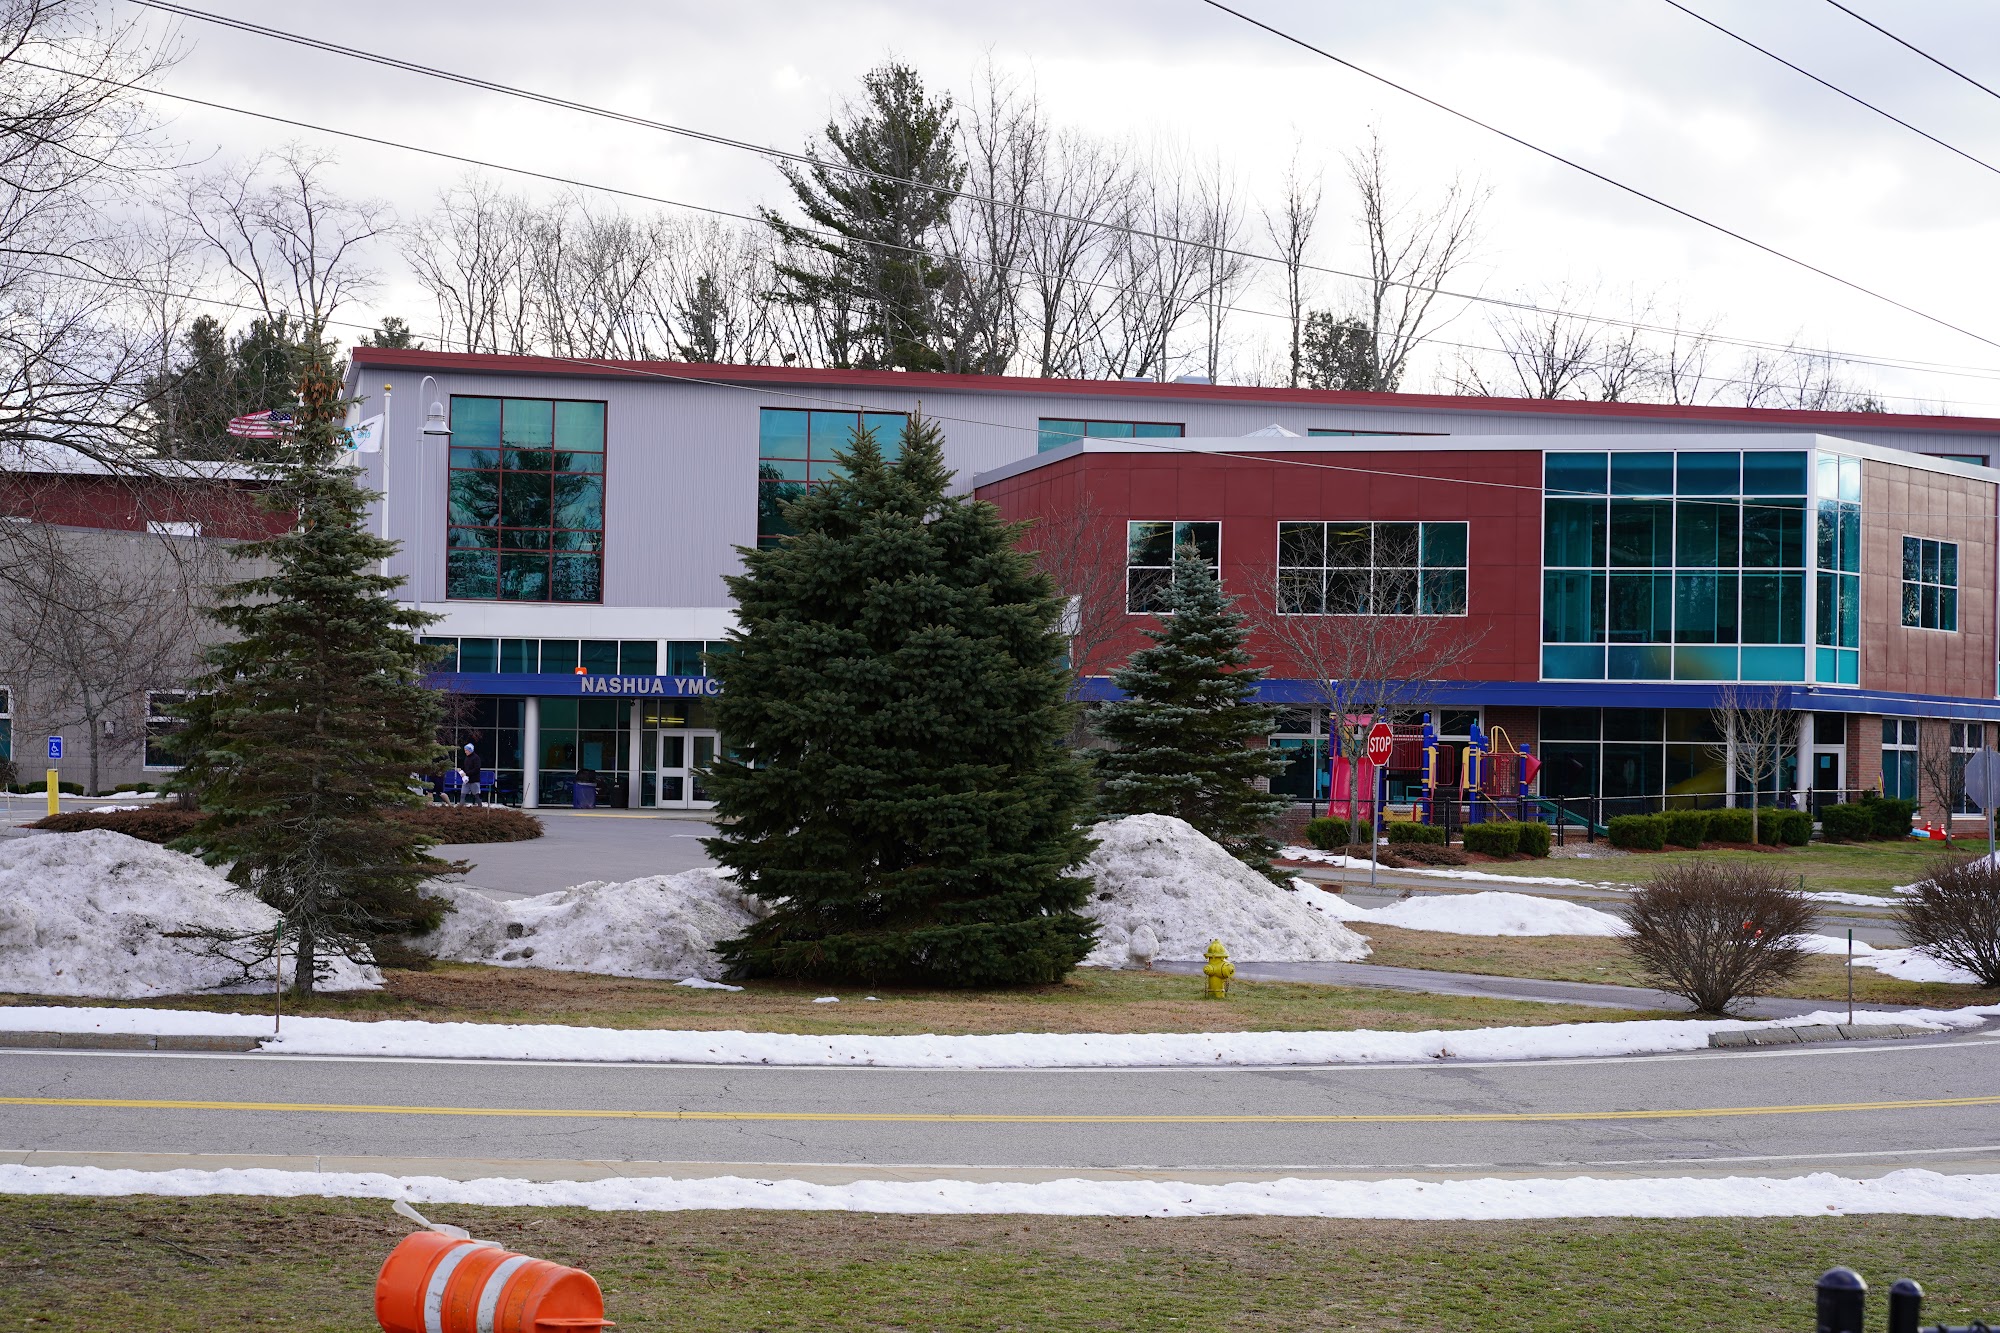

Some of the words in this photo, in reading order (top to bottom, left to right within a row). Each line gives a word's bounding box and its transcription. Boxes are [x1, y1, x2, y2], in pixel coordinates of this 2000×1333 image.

[581, 677, 664, 694] NASHUA
[674, 678, 725, 695] YMC
[1370, 736, 1391, 752] STOP
